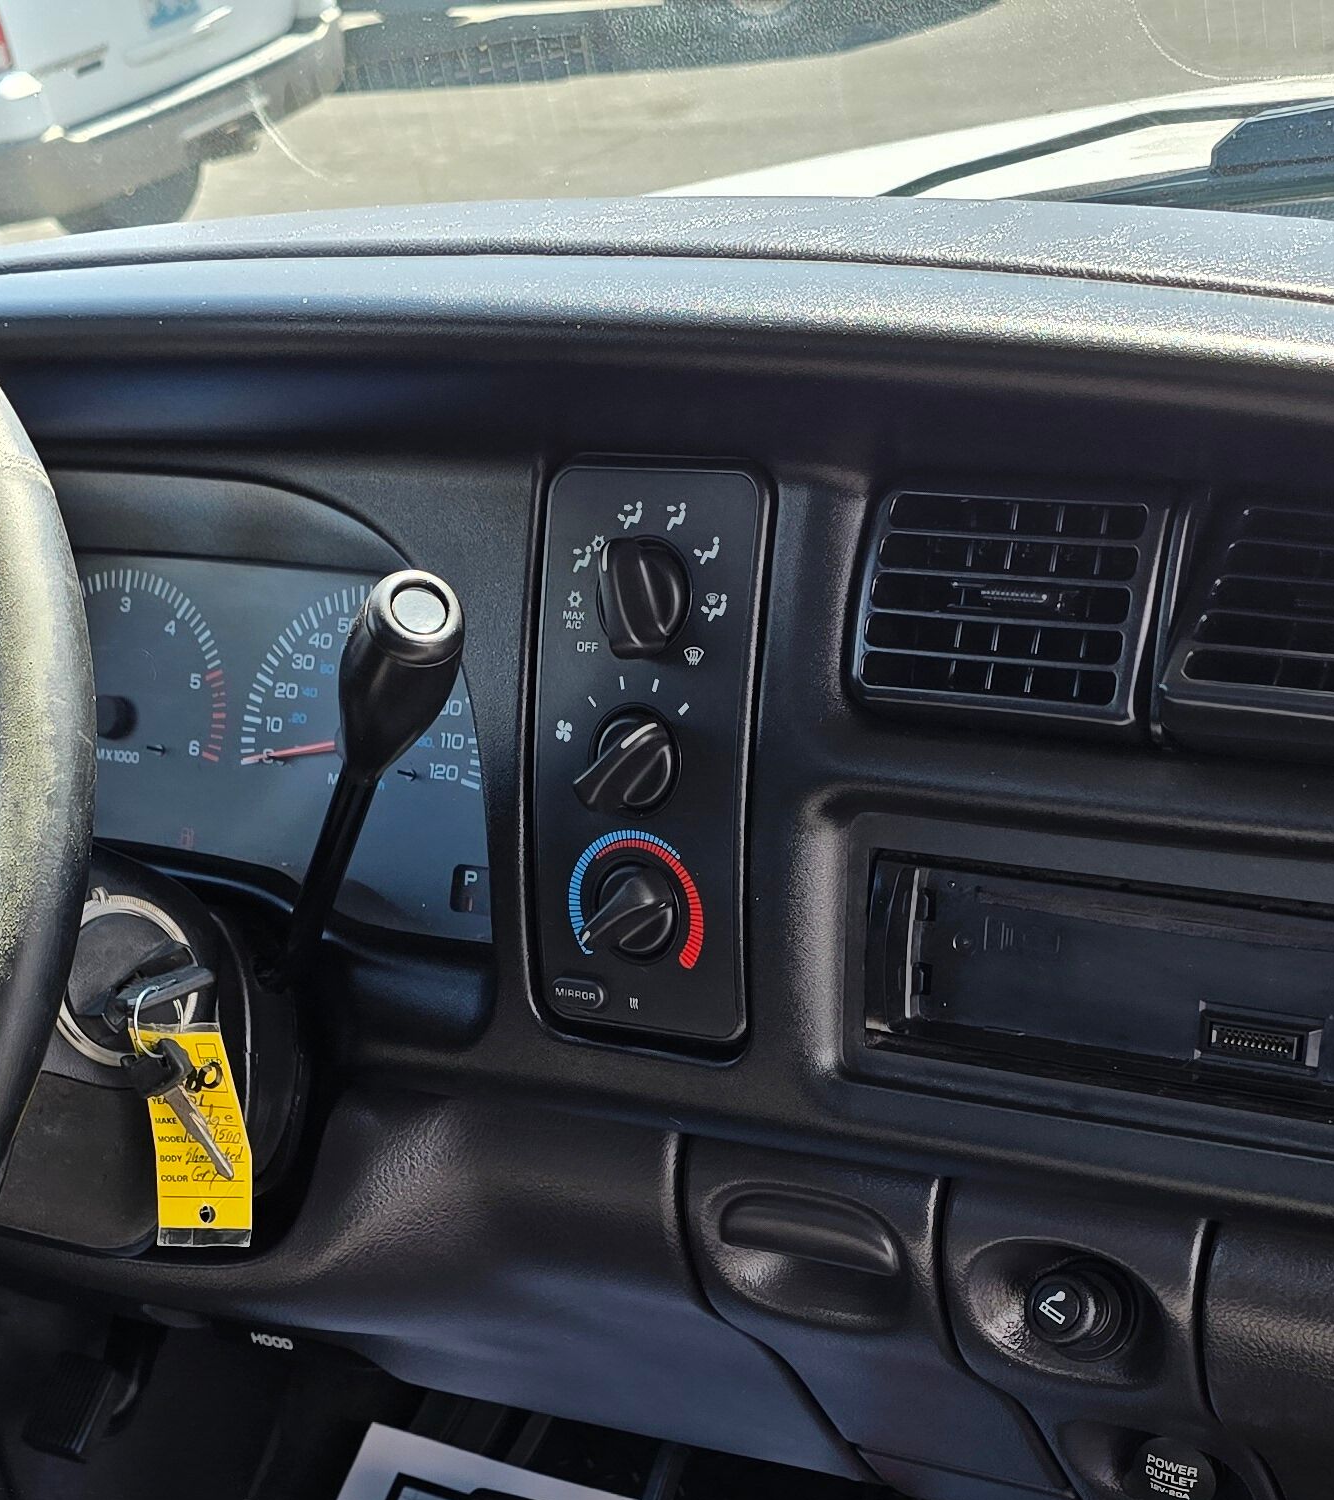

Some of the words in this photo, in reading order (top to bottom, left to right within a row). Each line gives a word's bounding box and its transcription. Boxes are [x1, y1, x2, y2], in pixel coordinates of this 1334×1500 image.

[120, 596, 131, 613] 3
[562, 610, 585, 621] MAX
[164, 620, 176, 636] 4
[565, 620, 582, 630] A/C
[308, 632, 333, 649] 40
[576, 641, 599, 653] OFF
[291, 654, 316, 671] 30
[189, 673, 201, 690] 5
[274, 682, 299, 699] 20
[266, 716, 283, 733] 10
[188, 740, 200, 756] 6
[441, 732, 465, 750] 110
[429, 763, 459, 781] 120
[464, 870, 477, 886] P
[555, 987, 596, 1001] MIRROR
[152, 1097, 167, 1105] YEA
[155, 1116, 178, 1125] MAKE
[158, 1135, 185, 1143] MODEL
[160, 1154, 182, 1163] BODY
[161, 1174, 188, 1182] COLOR
[251, 1332, 294, 1350] HOOD
[1147, 1453, 1198, 1477] POWER
[1145, 1465, 1198, 1488] OUTLET
